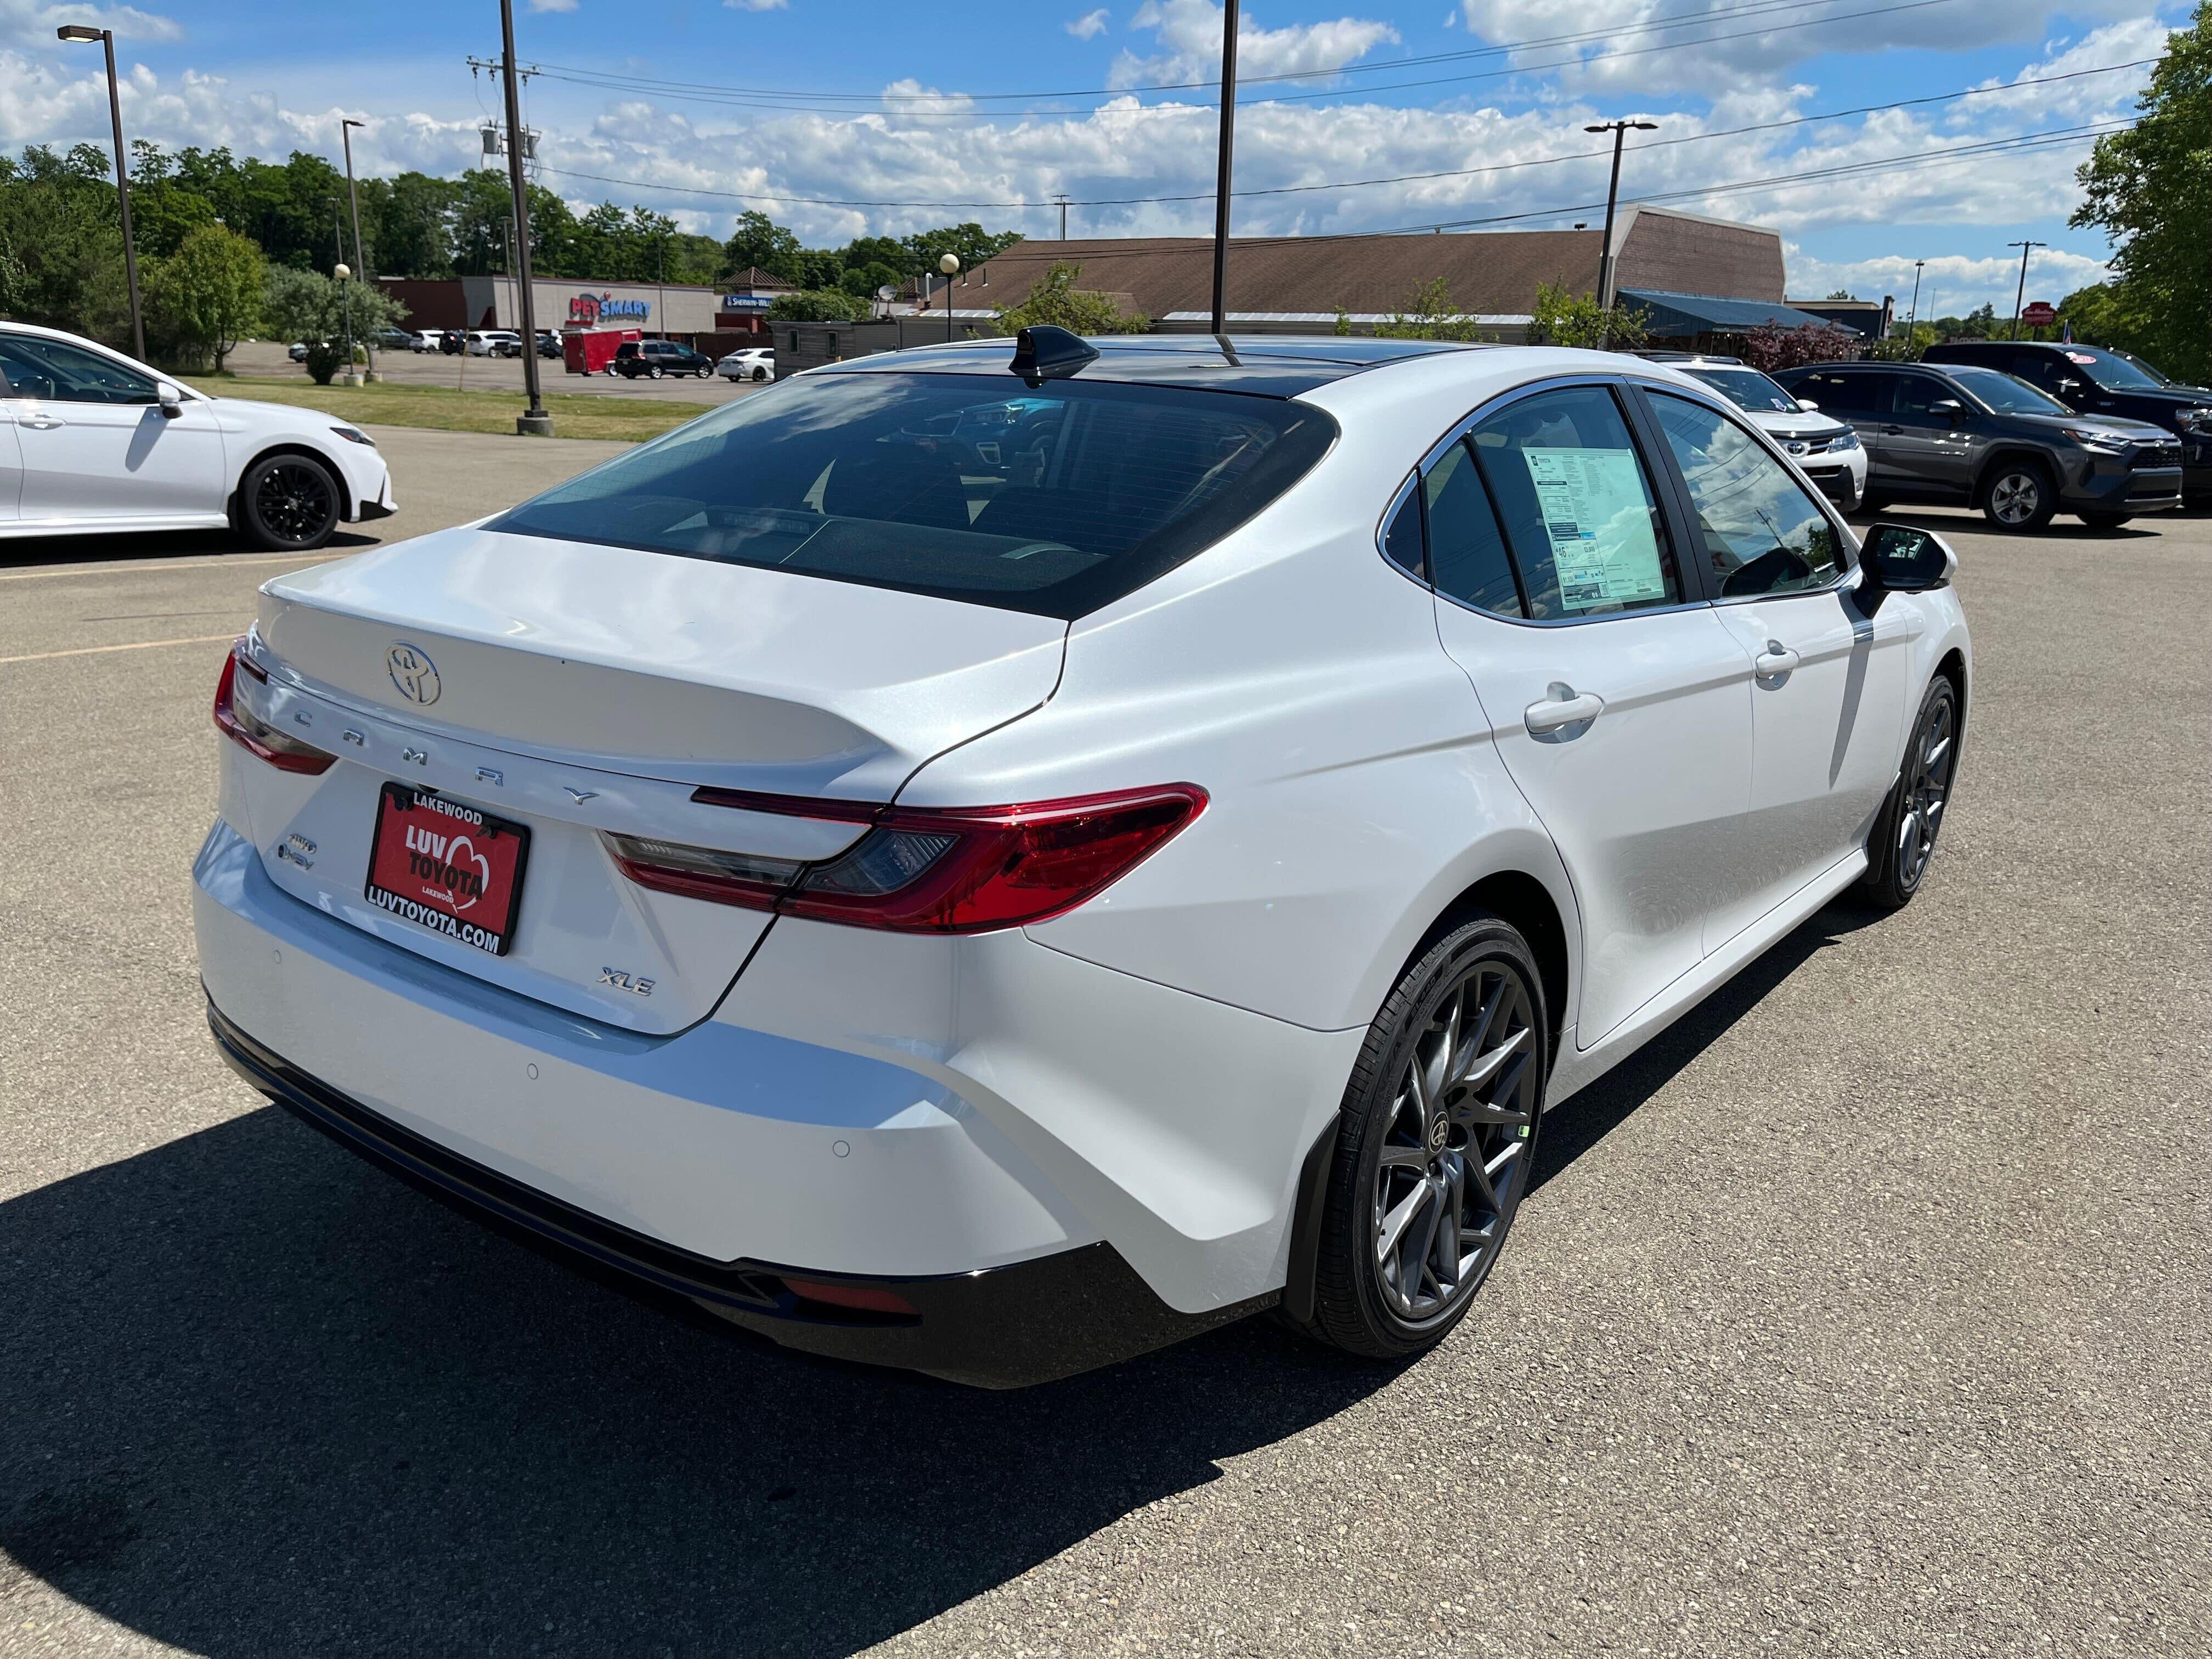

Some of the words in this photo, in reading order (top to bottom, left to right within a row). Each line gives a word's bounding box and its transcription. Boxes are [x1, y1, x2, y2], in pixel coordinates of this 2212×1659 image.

[572, 298, 651, 317] PETSMART
[294, 710, 600, 806] CAMRY
[414, 792, 483, 825] LAKEWOOD
[405, 825, 447, 859] LUV
[410, 851, 483, 900] TOYOTA
[422, 885, 454, 904] LAKEWOOD
[368, 885, 500, 954] LUVTOYOTA.COM
[596, 967, 656, 996] XLE
